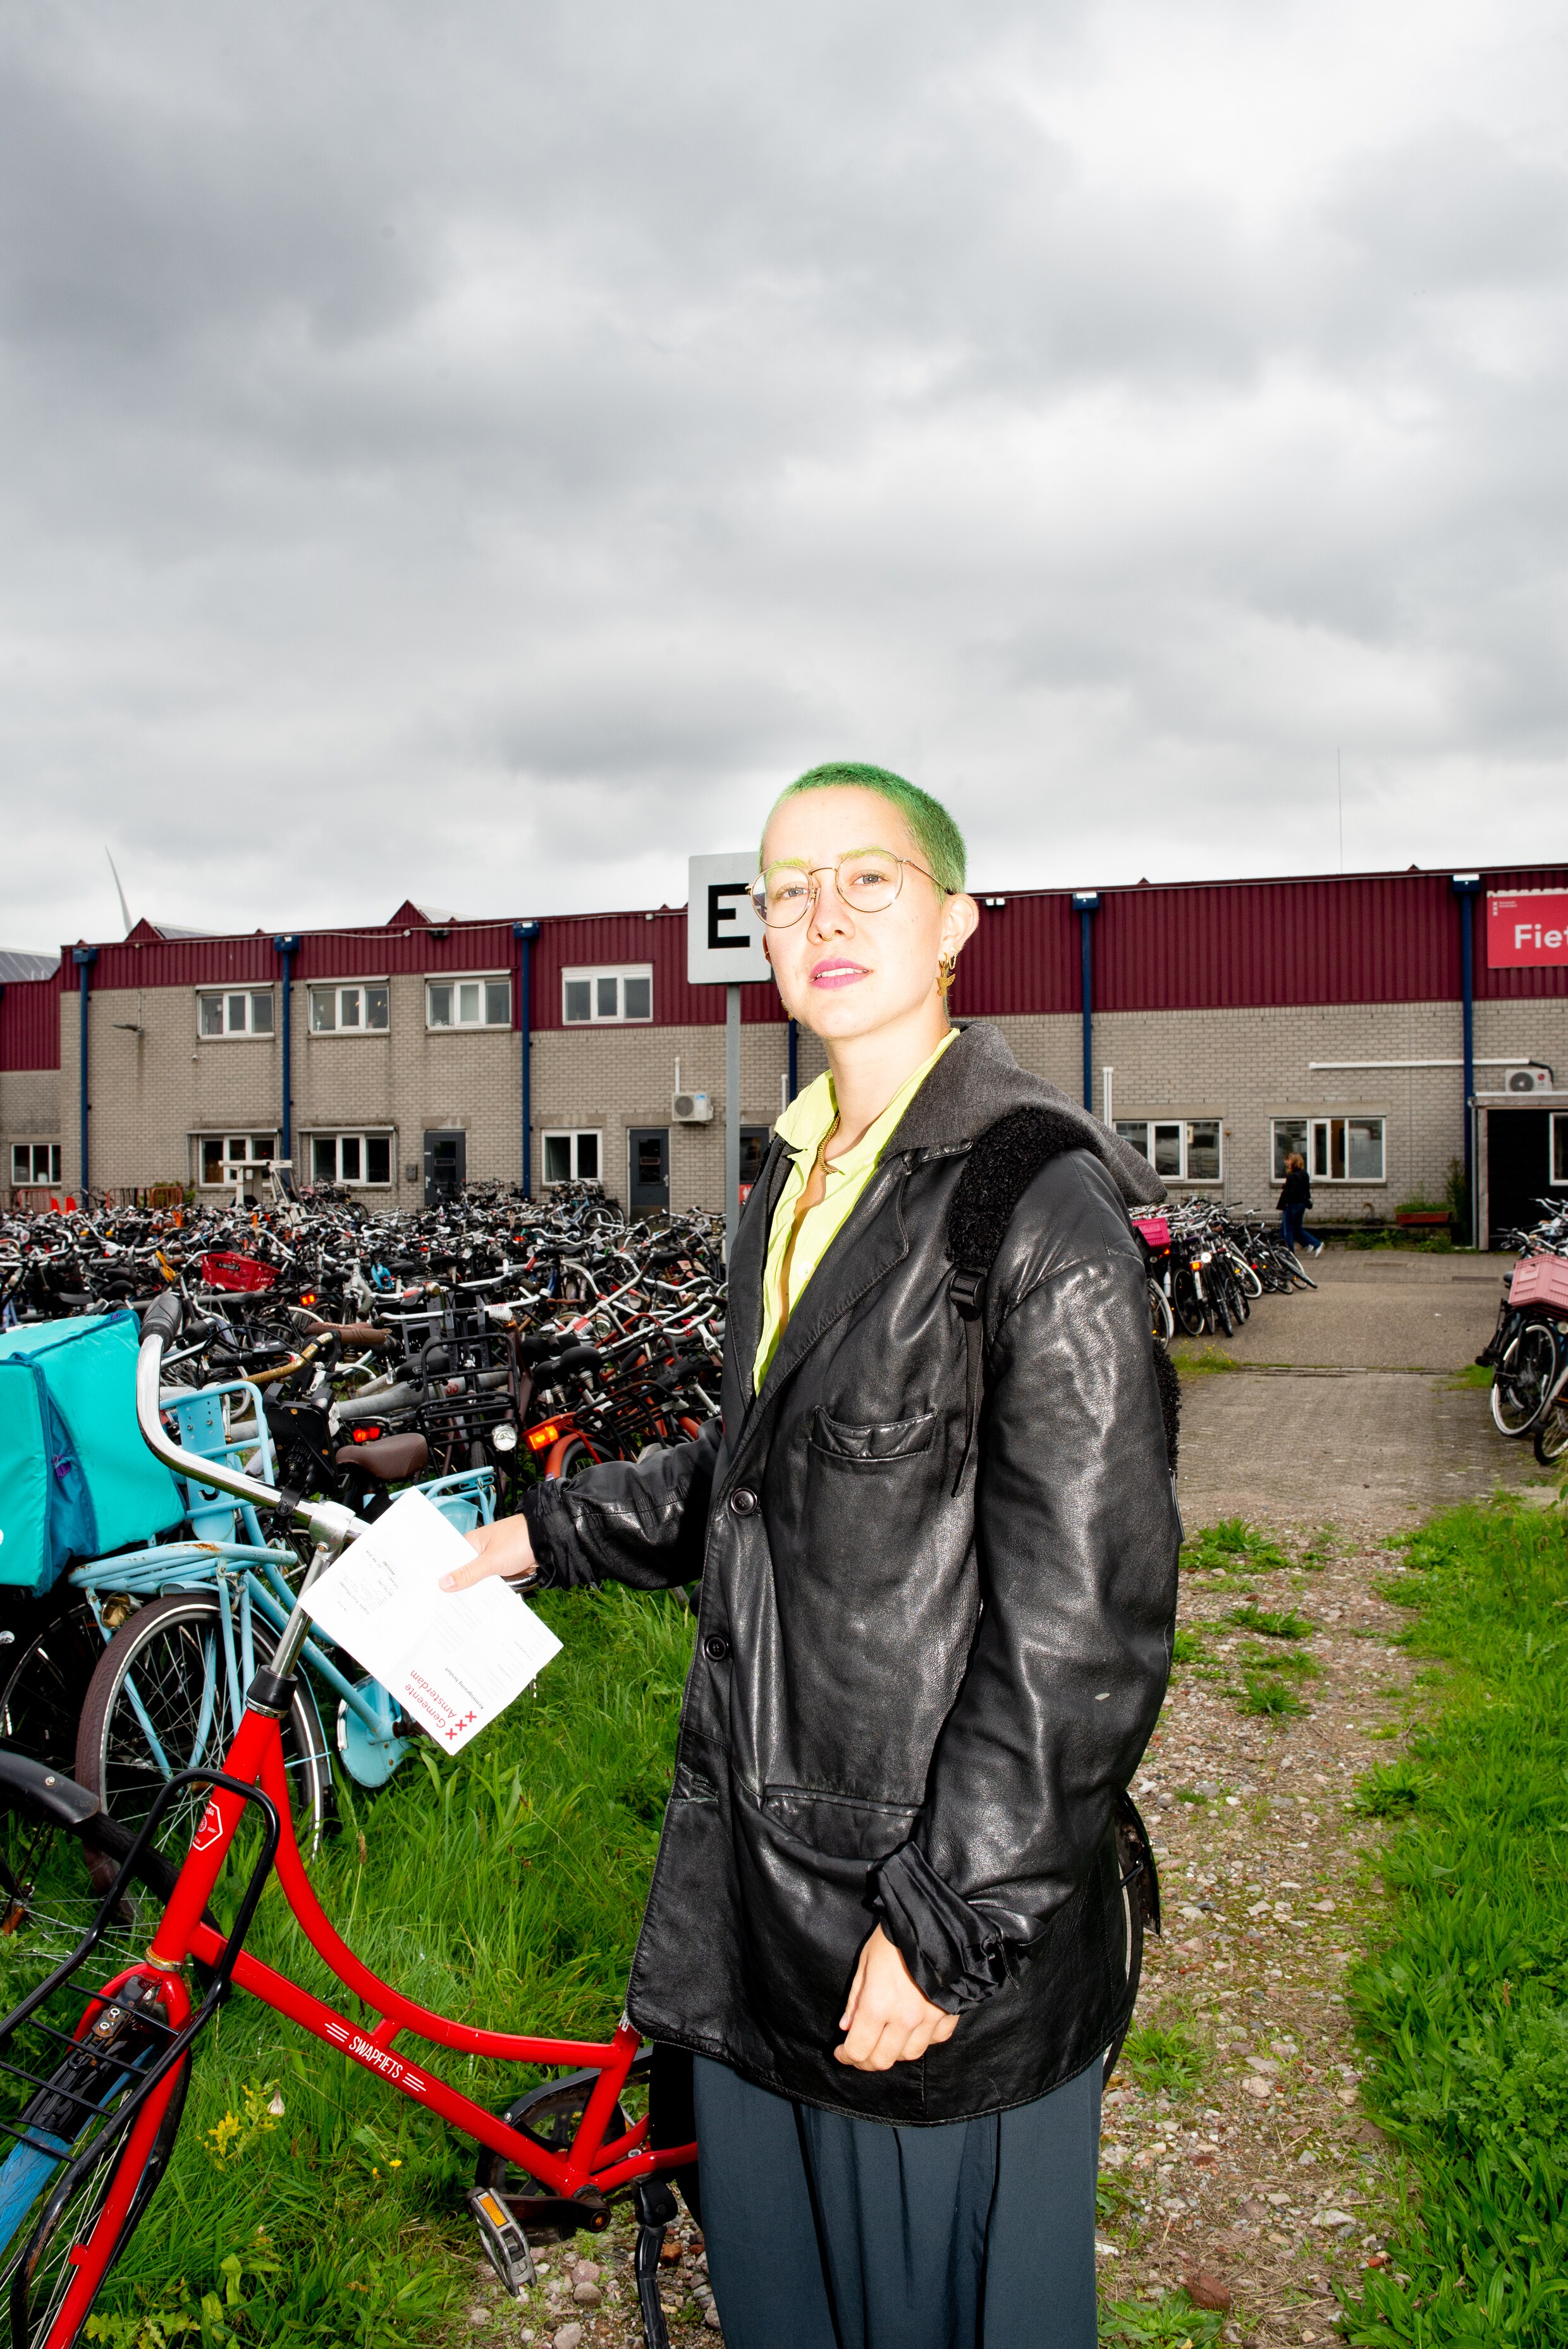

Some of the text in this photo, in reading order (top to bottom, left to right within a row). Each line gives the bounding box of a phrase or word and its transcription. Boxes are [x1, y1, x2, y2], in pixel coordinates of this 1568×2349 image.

[708, 883, 750, 949] E
[405, 1684, 446, 1728] Gemeente
[410, 1669, 458, 1719] Amsterdam
[445, 1667, 484, 1710] Kennisgeving besluit
[348, 2035, 403, 2078] SWAPFIETS
